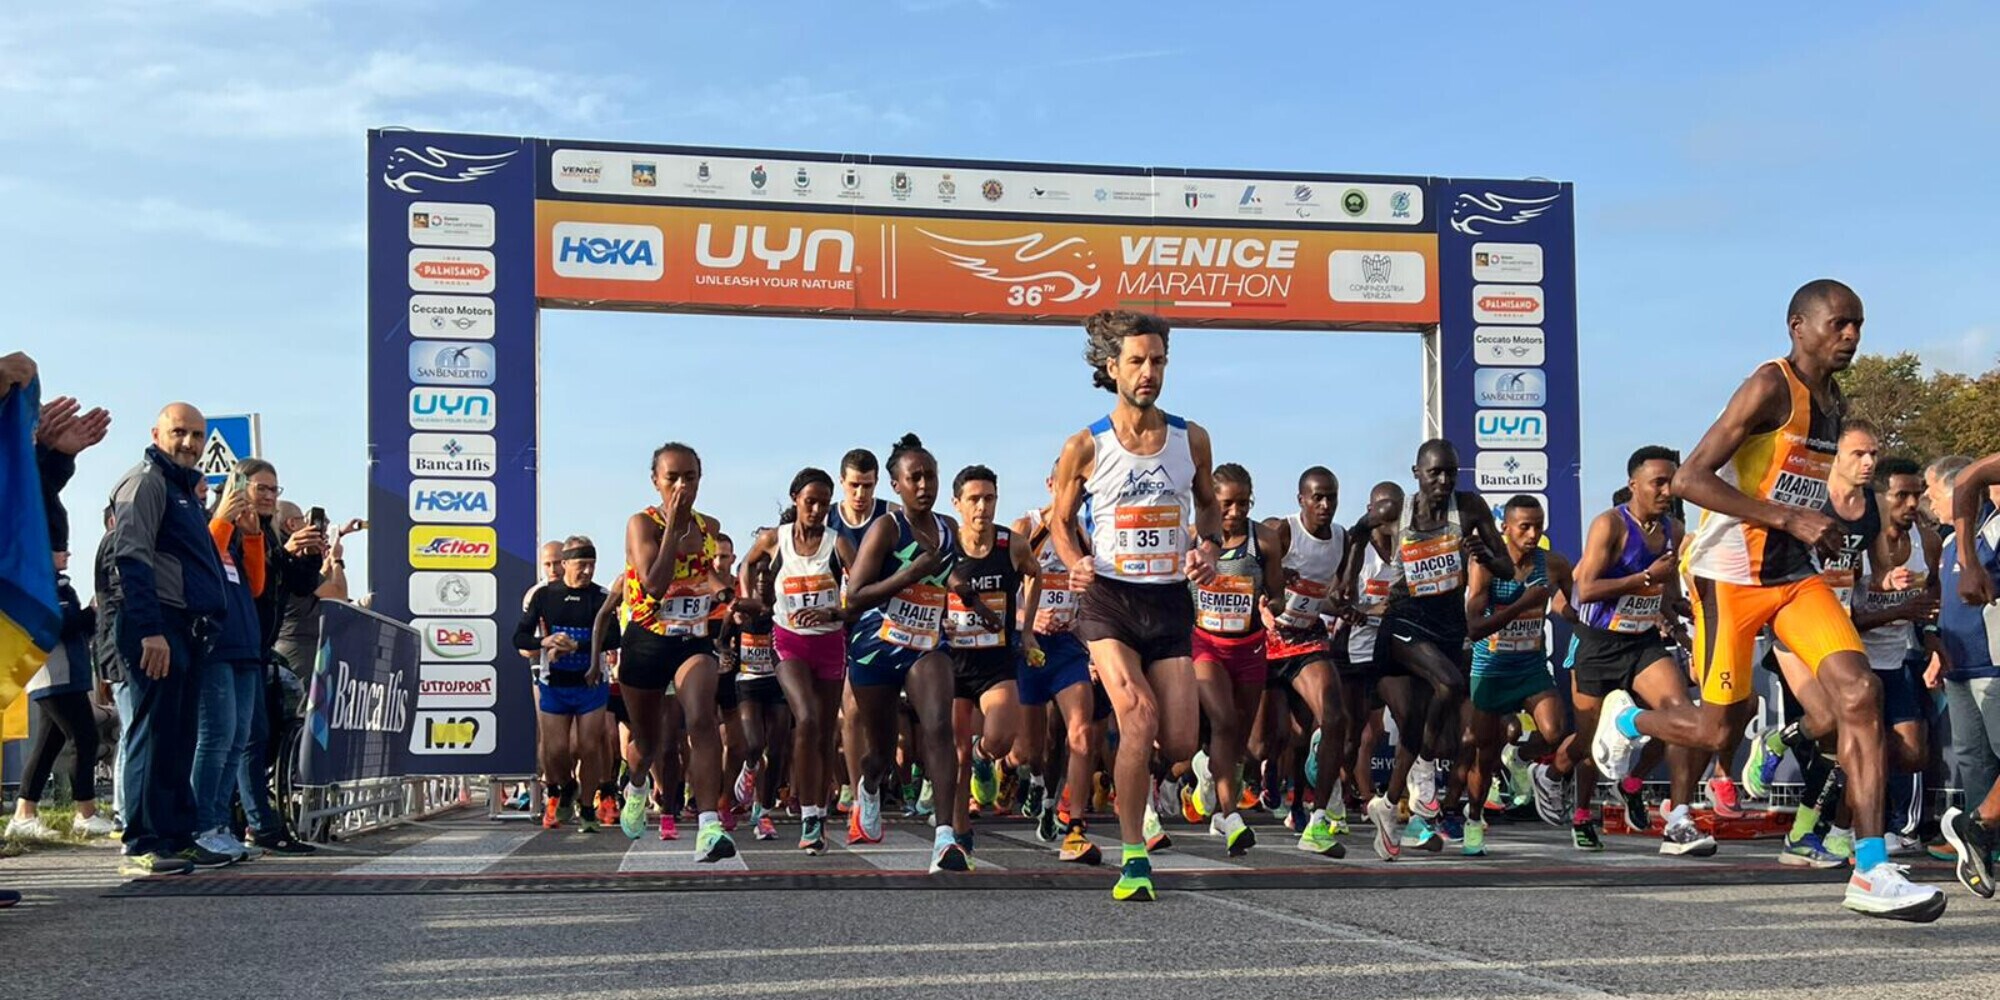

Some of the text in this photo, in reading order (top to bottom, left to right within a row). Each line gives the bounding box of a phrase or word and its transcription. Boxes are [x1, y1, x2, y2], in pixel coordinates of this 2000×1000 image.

[560, 237, 655, 266] HOKA
[695, 223, 855, 273] UYN
[1120, 236, 1299, 269] VENICE
[424, 265, 480, 277] PALMISANO
[696, 275, 854, 290] UNLEASH YOUR NATURE
[1117, 272, 1291, 298] MARATHON
[1350, 284, 1404, 292] CONFINDUSTRIA
[412, 304, 493, 316] Ceccato Motors
[1485, 300, 1532, 309] PALMISANO
[1476, 335, 1543, 345] Ceccato Motors
[413, 394, 489, 416] UYN
[1479, 416, 1541, 435] UYN
[416, 458, 490, 472] Banca Ifis
[1481, 474, 1542, 486] Banca Ifis
[415, 490, 488, 511] HOKA
[1137, 530, 1159, 548] 35
[1412, 554, 1456, 574] JACOB
[802, 593, 820, 607] F7
[1048, 591, 1064, 604] 36
[1200, 590, 1251, 607] GEMEDA
[1299, 597, 1310, 609] 2
[683, 598, 700, 615] F8
[899, 601, 937, 621] HAILE
[437, 629, 473, 643] Dole
[330, 660, 408, 733] Banca Ifis
